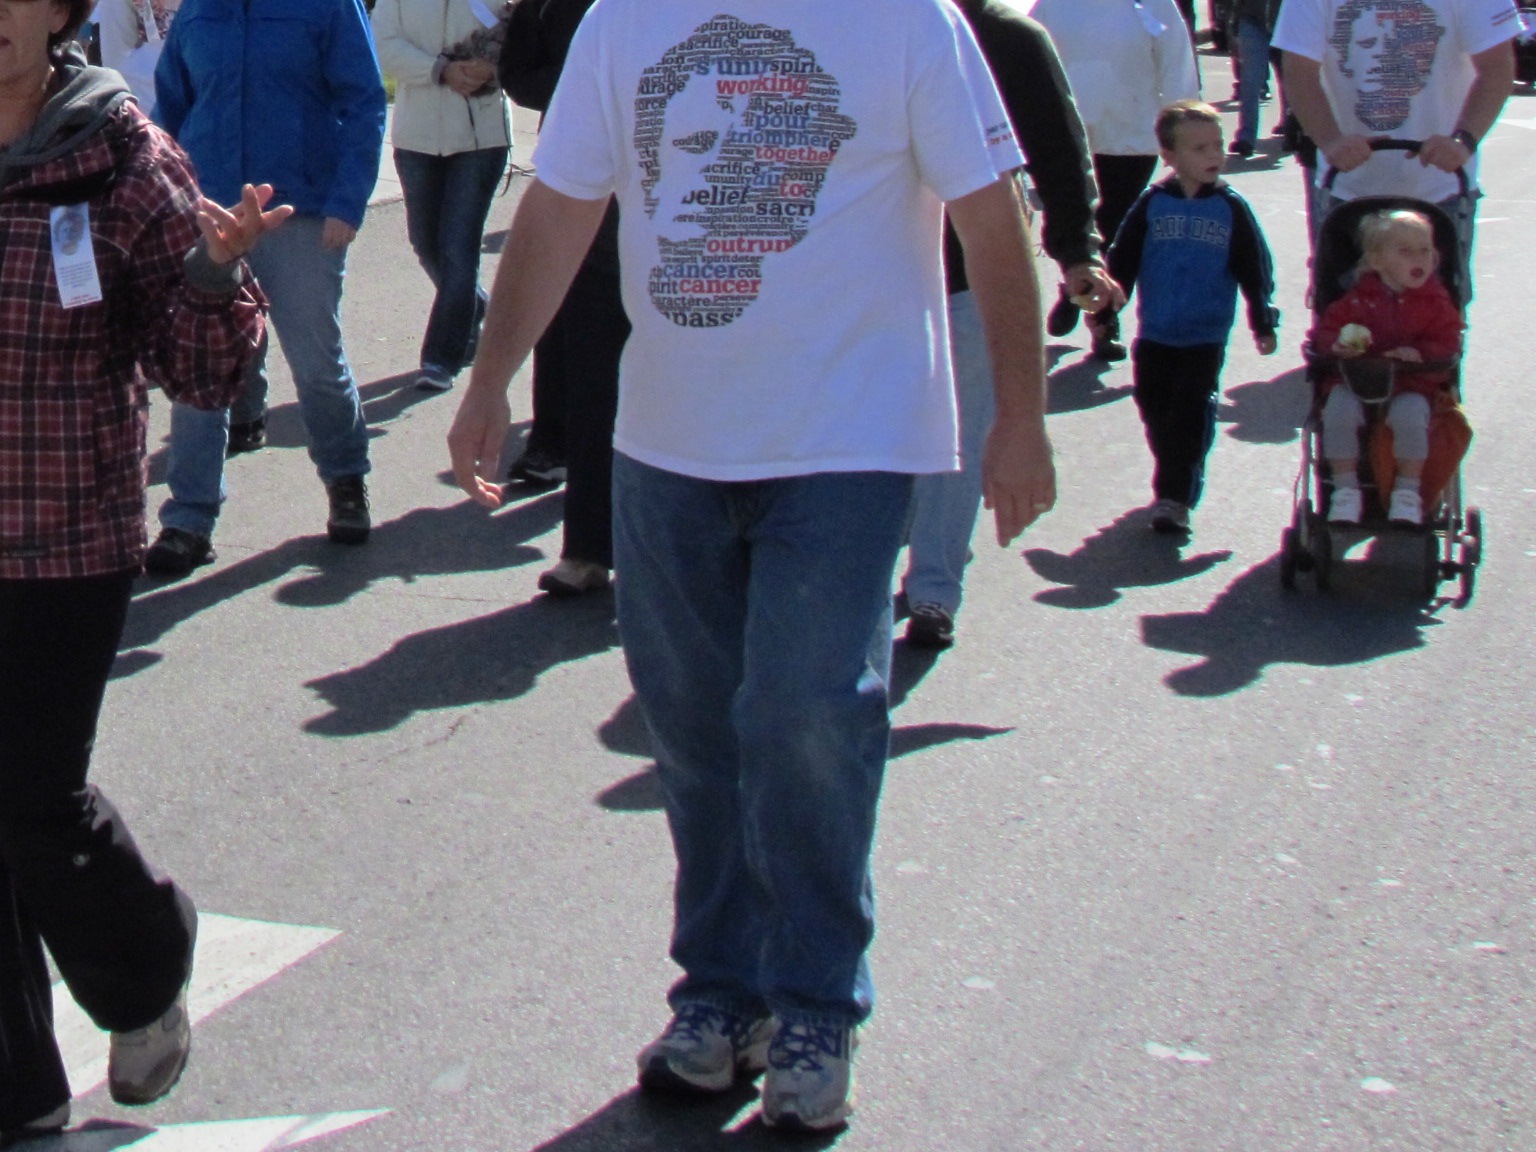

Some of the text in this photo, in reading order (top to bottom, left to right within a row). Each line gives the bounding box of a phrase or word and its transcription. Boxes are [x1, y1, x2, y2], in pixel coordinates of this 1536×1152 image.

[643, 63, 696, 75] aracter
[716, 74, 809, 97] working
[755, 146, 837, 163] together
[752, 169, 780, 186] du
[779, 181, 804, 198] to
[664, 263, 738, 279] cancer
[679, 278, 762, 294] cancer
